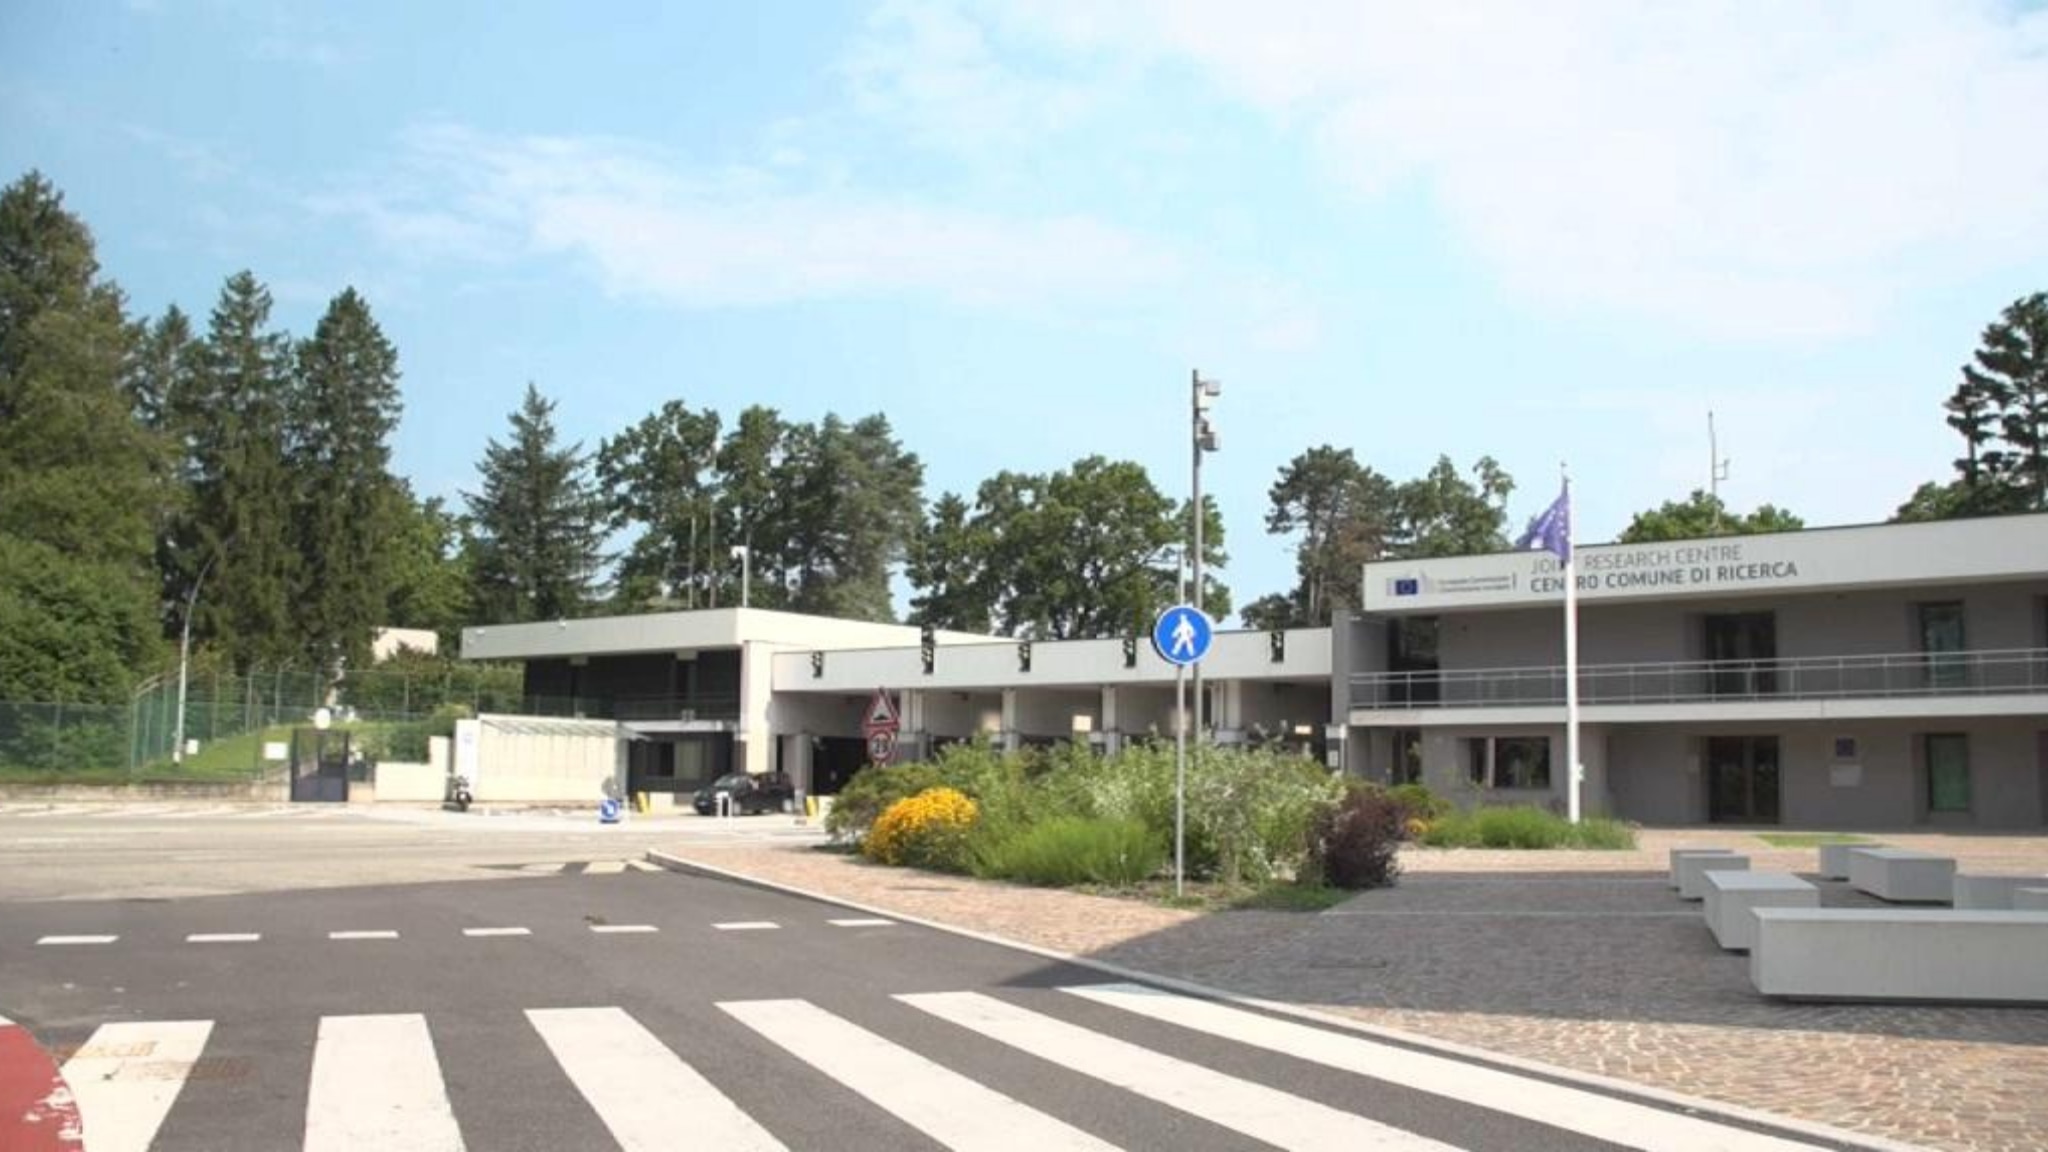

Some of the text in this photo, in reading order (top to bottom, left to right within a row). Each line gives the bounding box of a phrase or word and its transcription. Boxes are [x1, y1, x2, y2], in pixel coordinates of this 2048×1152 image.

[1585, 550, 1670, 570] RESEARCH
[1675, 544, 1743, 565] CENTRE
[1530, 575, 1598, 593] CENRO
[1605, 569, 1687, 588] COMUNE
[1690, 566, 1710, 584] DI
[1717, 561, 1797, 581] RICERCA
